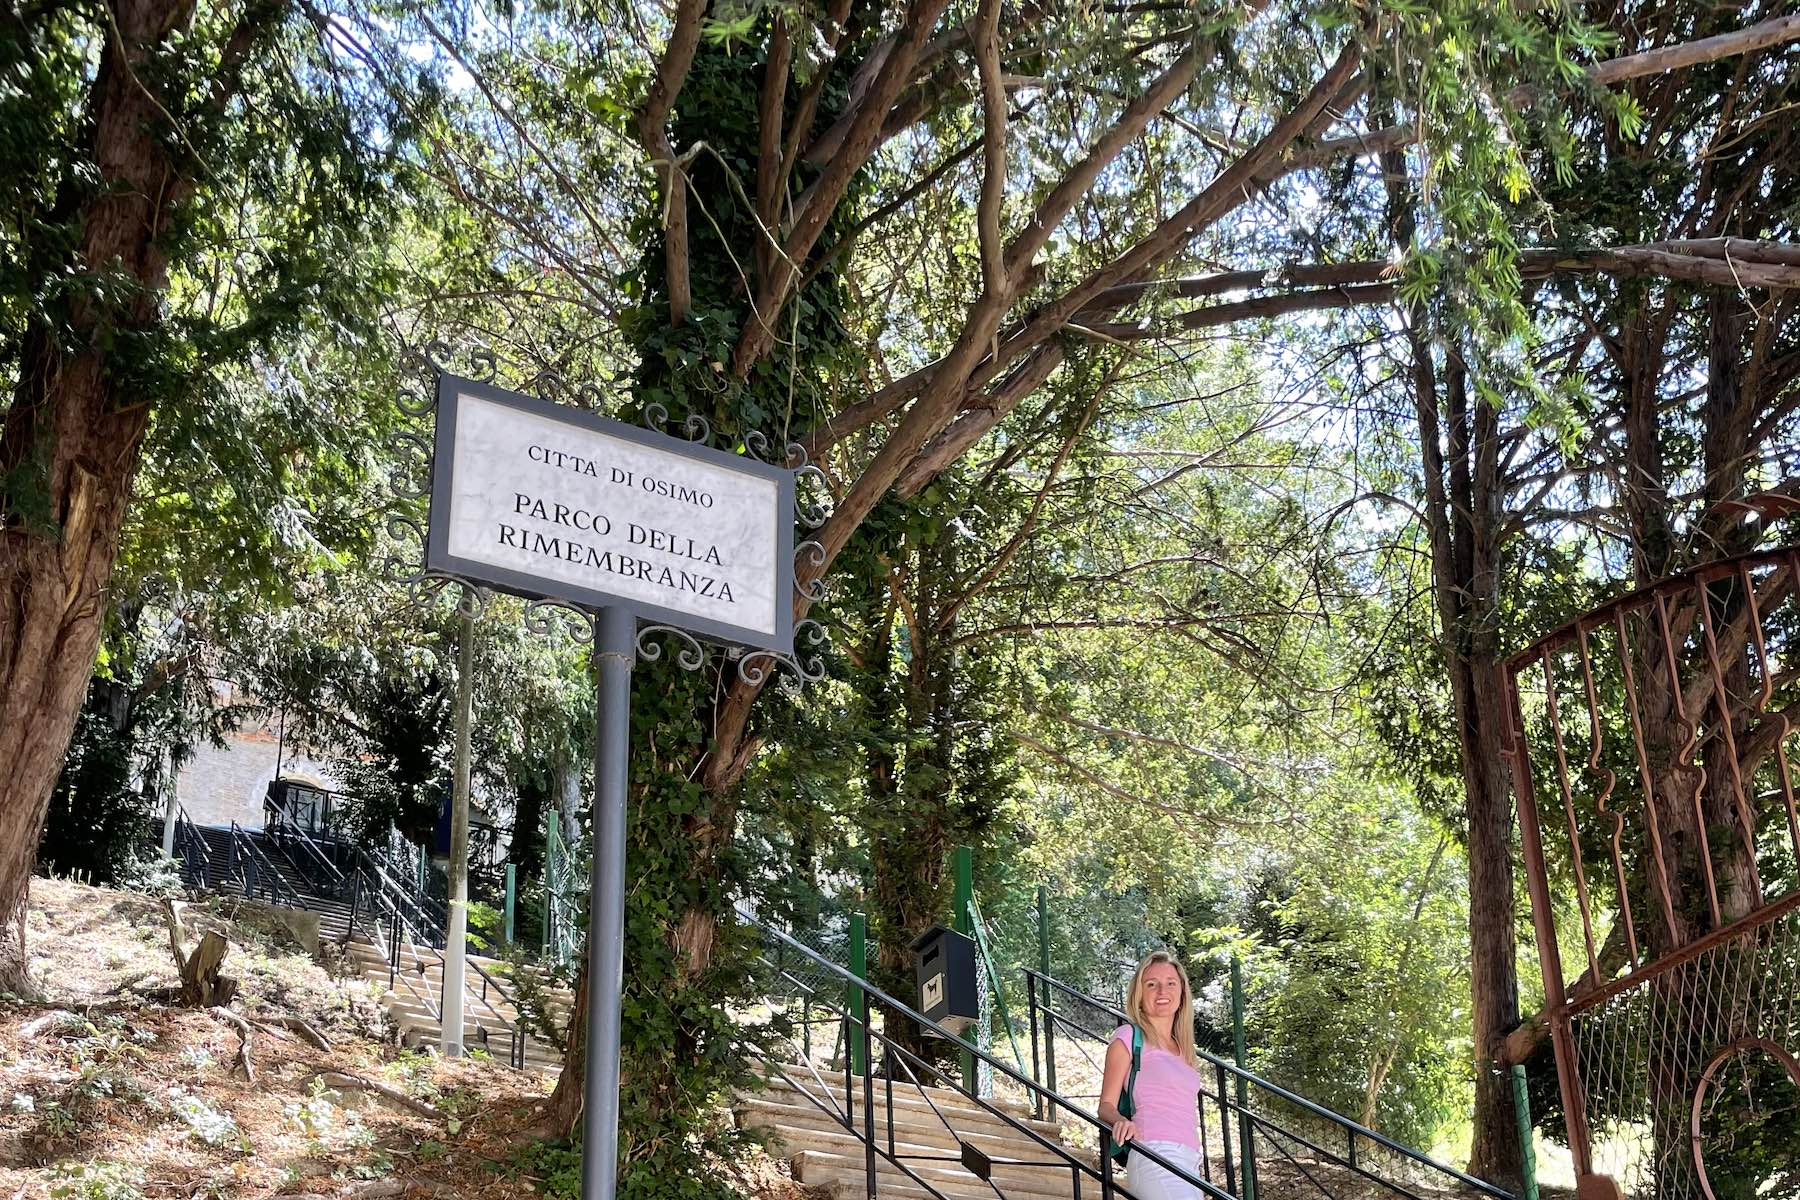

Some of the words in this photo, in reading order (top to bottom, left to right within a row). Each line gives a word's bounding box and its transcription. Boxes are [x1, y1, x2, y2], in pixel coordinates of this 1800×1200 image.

[611, 466, 633, 487] DI
[642, 477, 714, 508] OSIMO
[498, 523, 736, 603] RIMEMBRANZA
[513, 493, 611, 536] PARCO
[627, 523, 722, 566] DELLA
